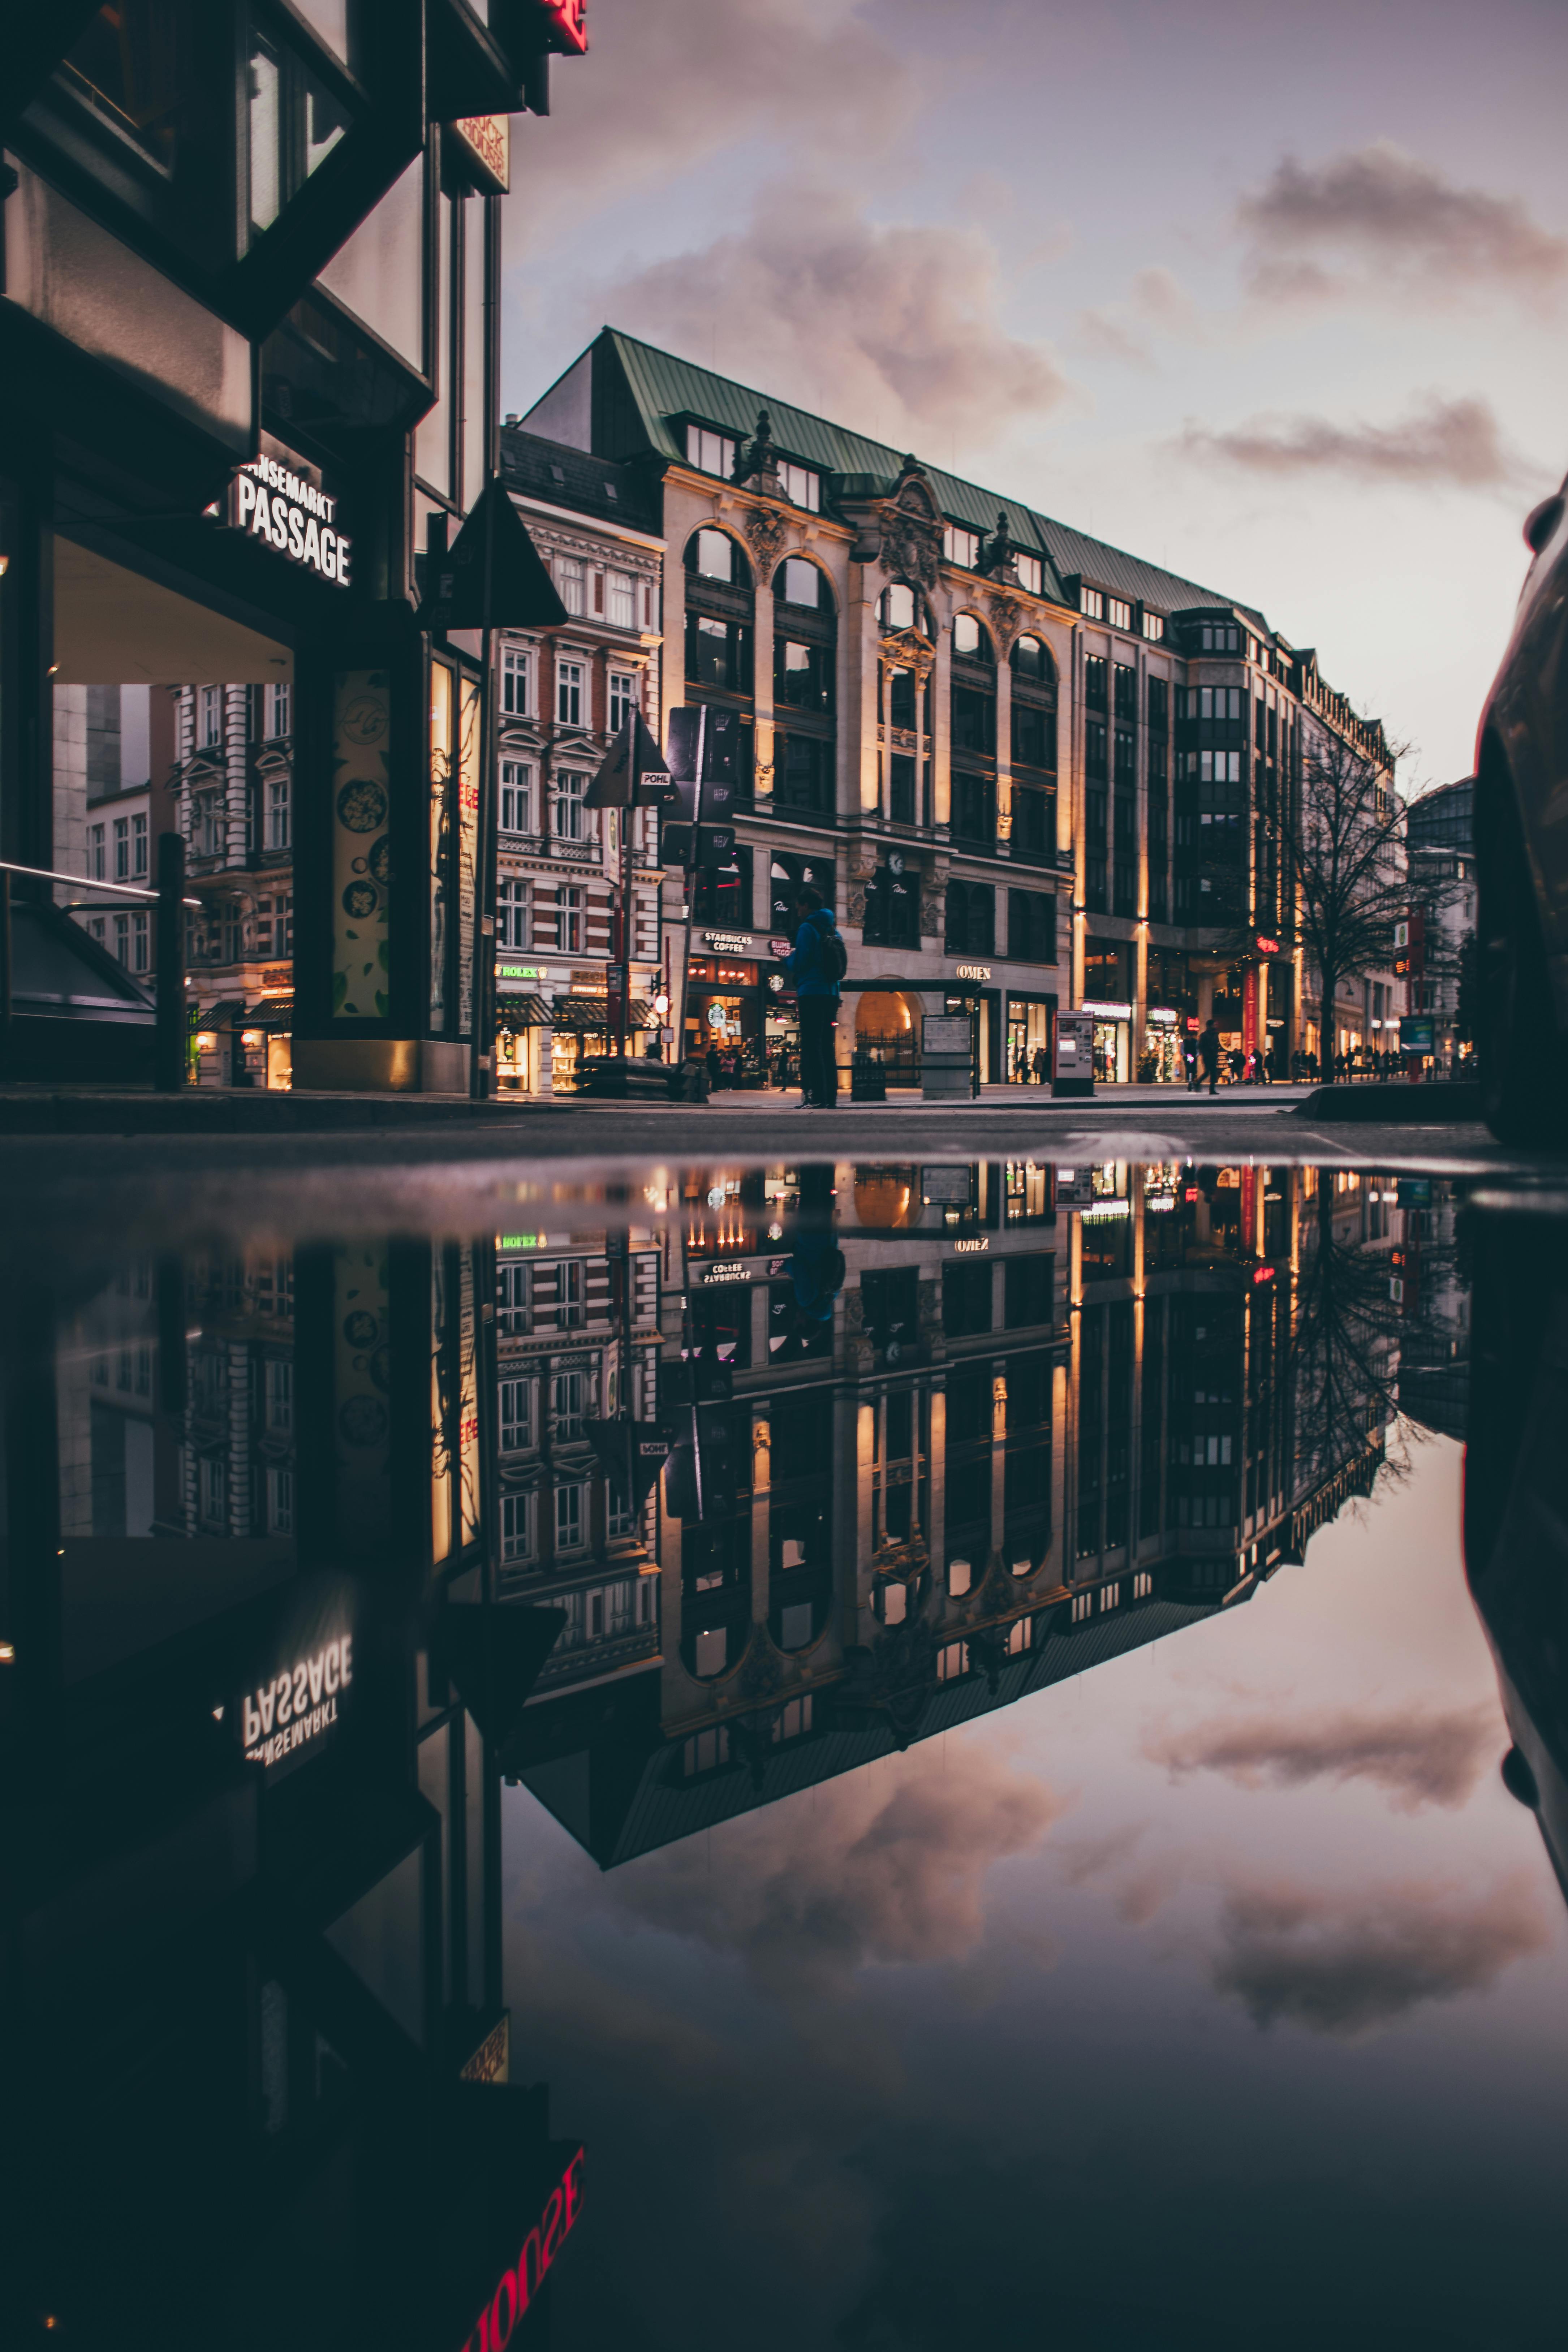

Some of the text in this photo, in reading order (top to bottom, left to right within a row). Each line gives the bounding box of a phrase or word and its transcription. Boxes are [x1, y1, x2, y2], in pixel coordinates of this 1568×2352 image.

[240, 454, 335, 523] NSEMARKT
[238, 473, 350, 587] PASSAGE
[644, 774, 668, 784] POHL
[705, 932, 753, 945] STARBUCKS
[713, 942, 744, 952] COFFEE
[502, 966, 538, 978] ROLEX
